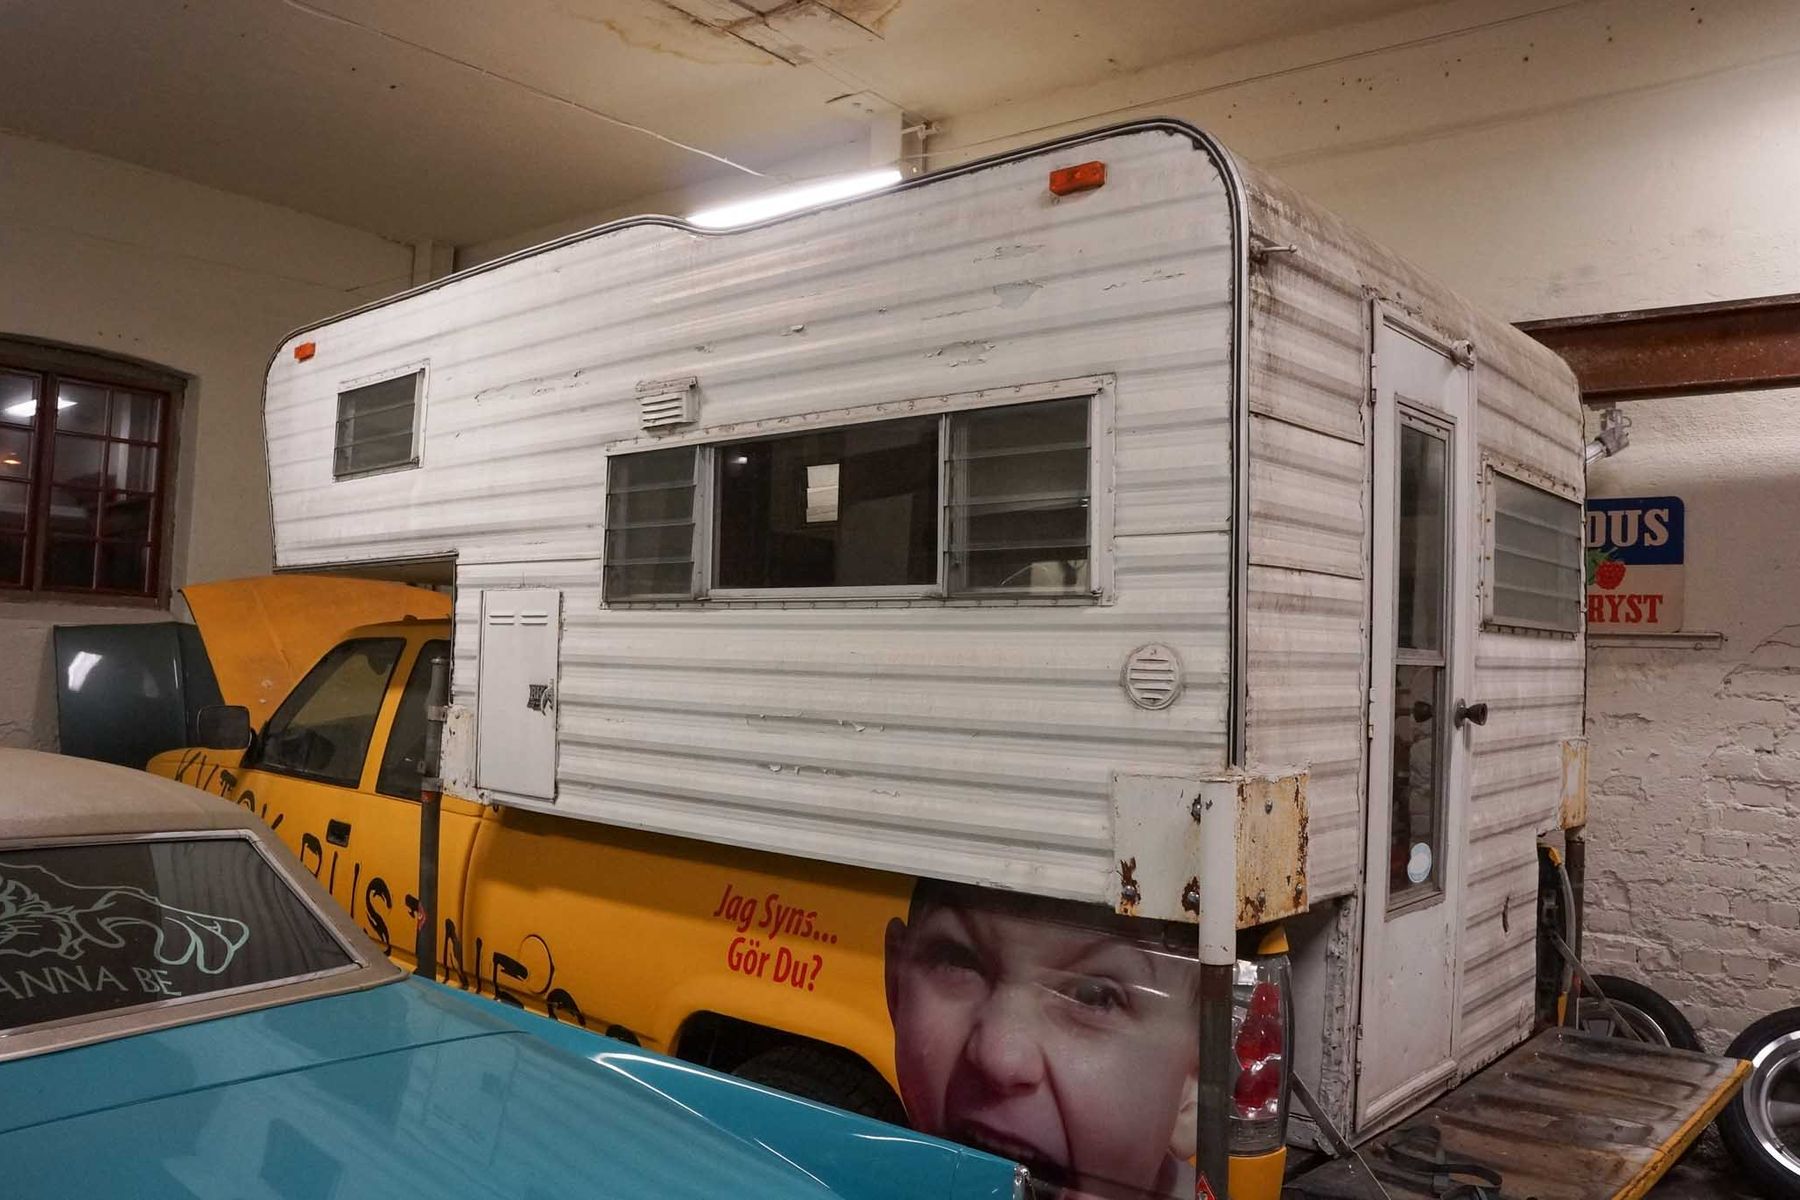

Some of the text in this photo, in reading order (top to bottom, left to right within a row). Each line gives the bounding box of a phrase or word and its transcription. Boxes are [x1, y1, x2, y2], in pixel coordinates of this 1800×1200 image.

[1587, 508, 1670, 547] DUS
[1588, 594, 1663, 623] RYST
[713, 884, 838, 944] Jag Syns...
[132, 966, 182, 996] BE
[728, 937, 823, 991] Gör Du?
